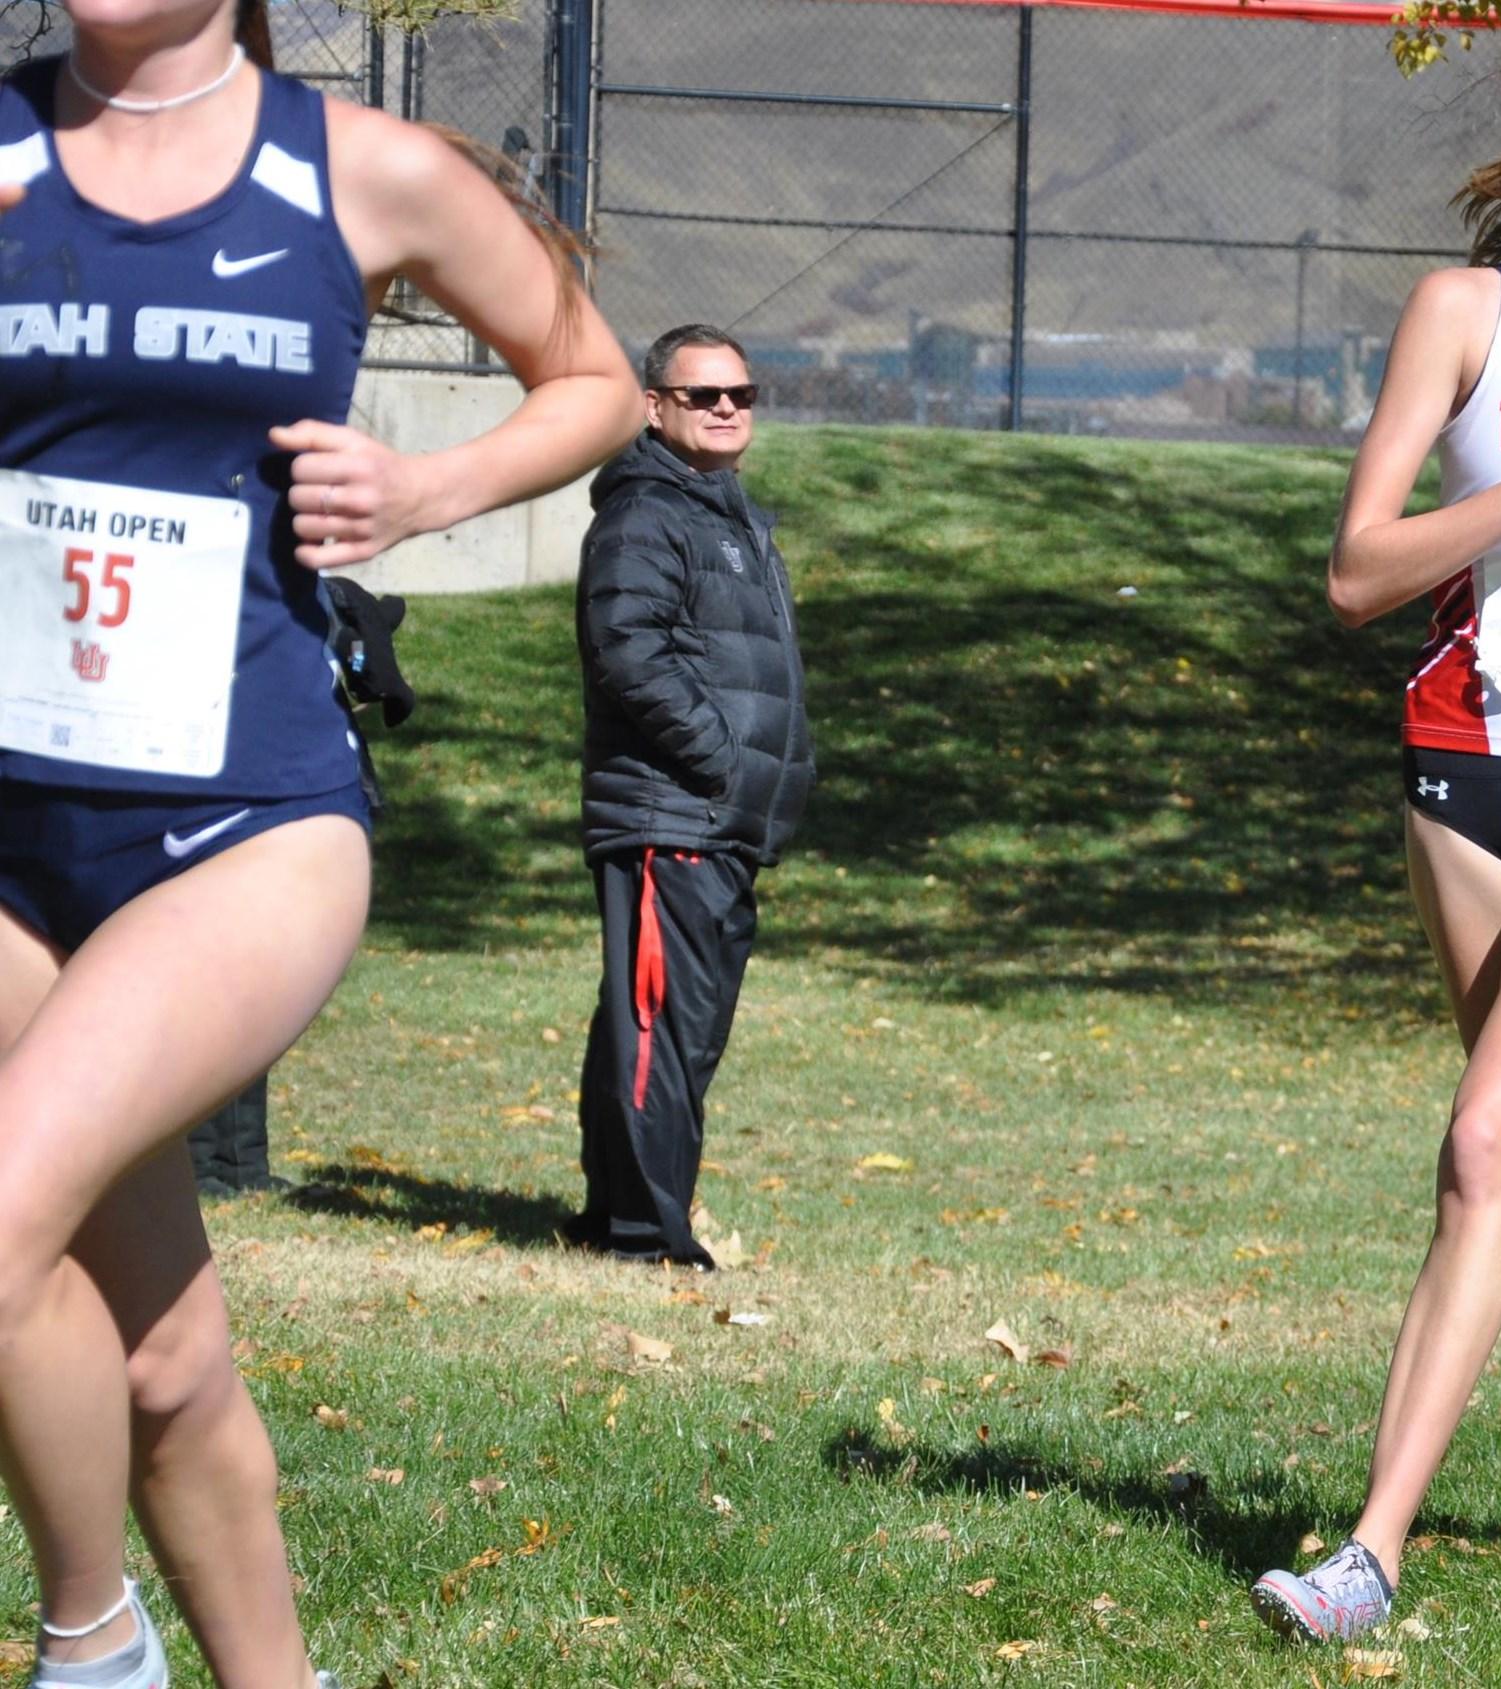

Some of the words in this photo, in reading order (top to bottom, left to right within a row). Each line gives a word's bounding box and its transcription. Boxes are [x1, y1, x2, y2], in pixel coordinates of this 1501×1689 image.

[0, 303, 108, 357] TAH
[134, 306, 312, 374] STATE
[27, 499, 97, 533] UTAH
[109, 512, 186, 544] OPEN
[63, 547, 134, 628] 55
